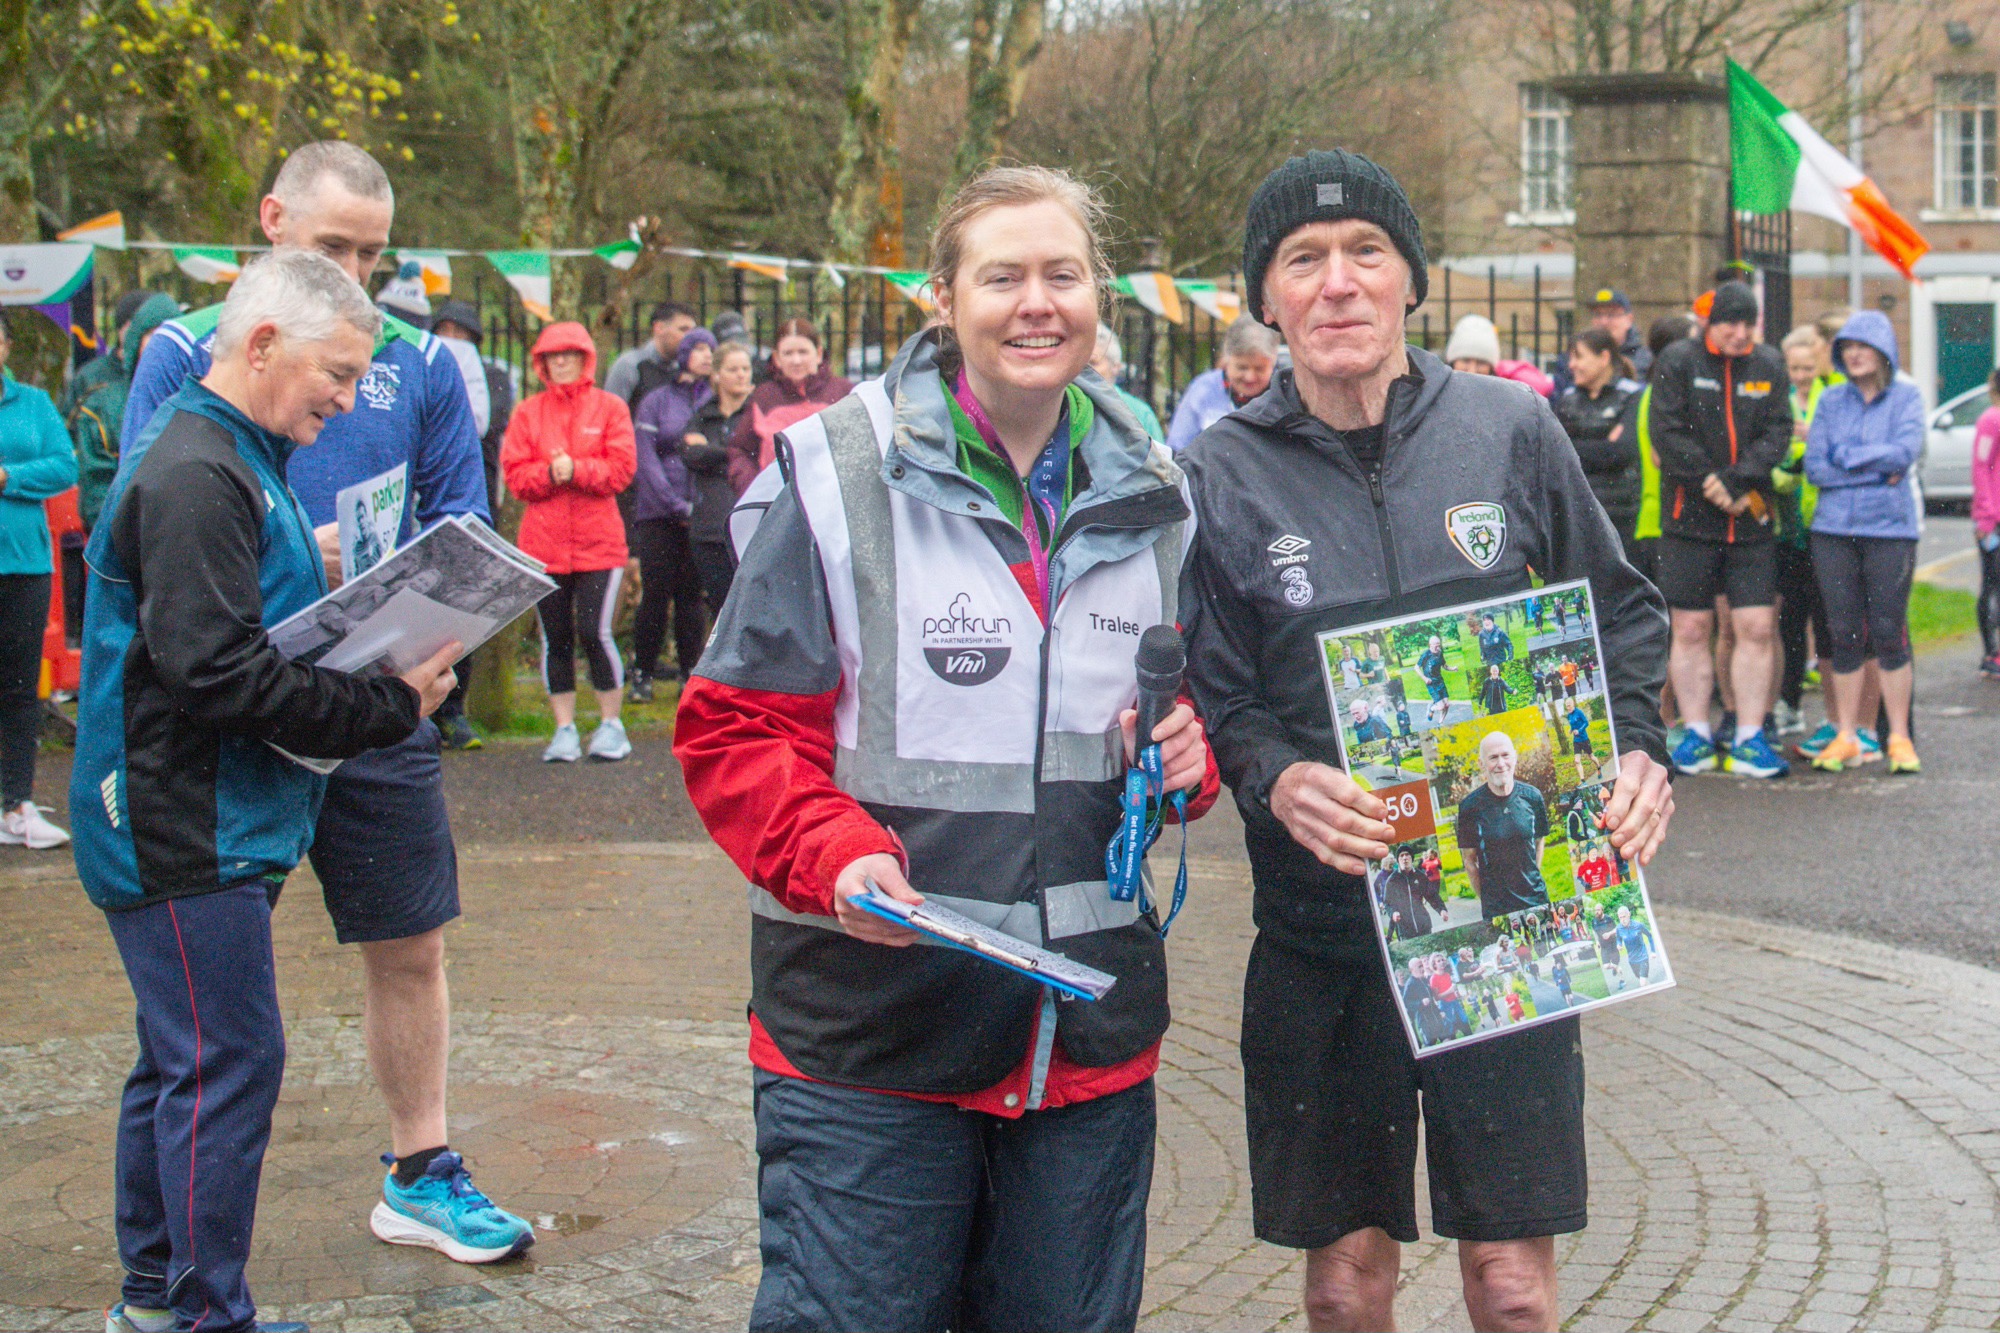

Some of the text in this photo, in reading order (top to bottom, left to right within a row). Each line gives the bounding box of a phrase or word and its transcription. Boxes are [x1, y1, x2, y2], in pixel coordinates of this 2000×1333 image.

[1455, 510, 1497, 523] Ireland
[1272, 554, 1309, 566] umbro
[923, 606, 1011, 639] parkrun
[1089, 612, 1139, 636] Tralee
[946, 653, 984, 673] Vhi
[1131, 815, 1139, 828] Get
[1129, 828, 1137, 840] the
[1128, 840, 1137, 851] flu
[1125, 852, 1134, 879] vaccine
[1121, 889, 1129, 898] did
